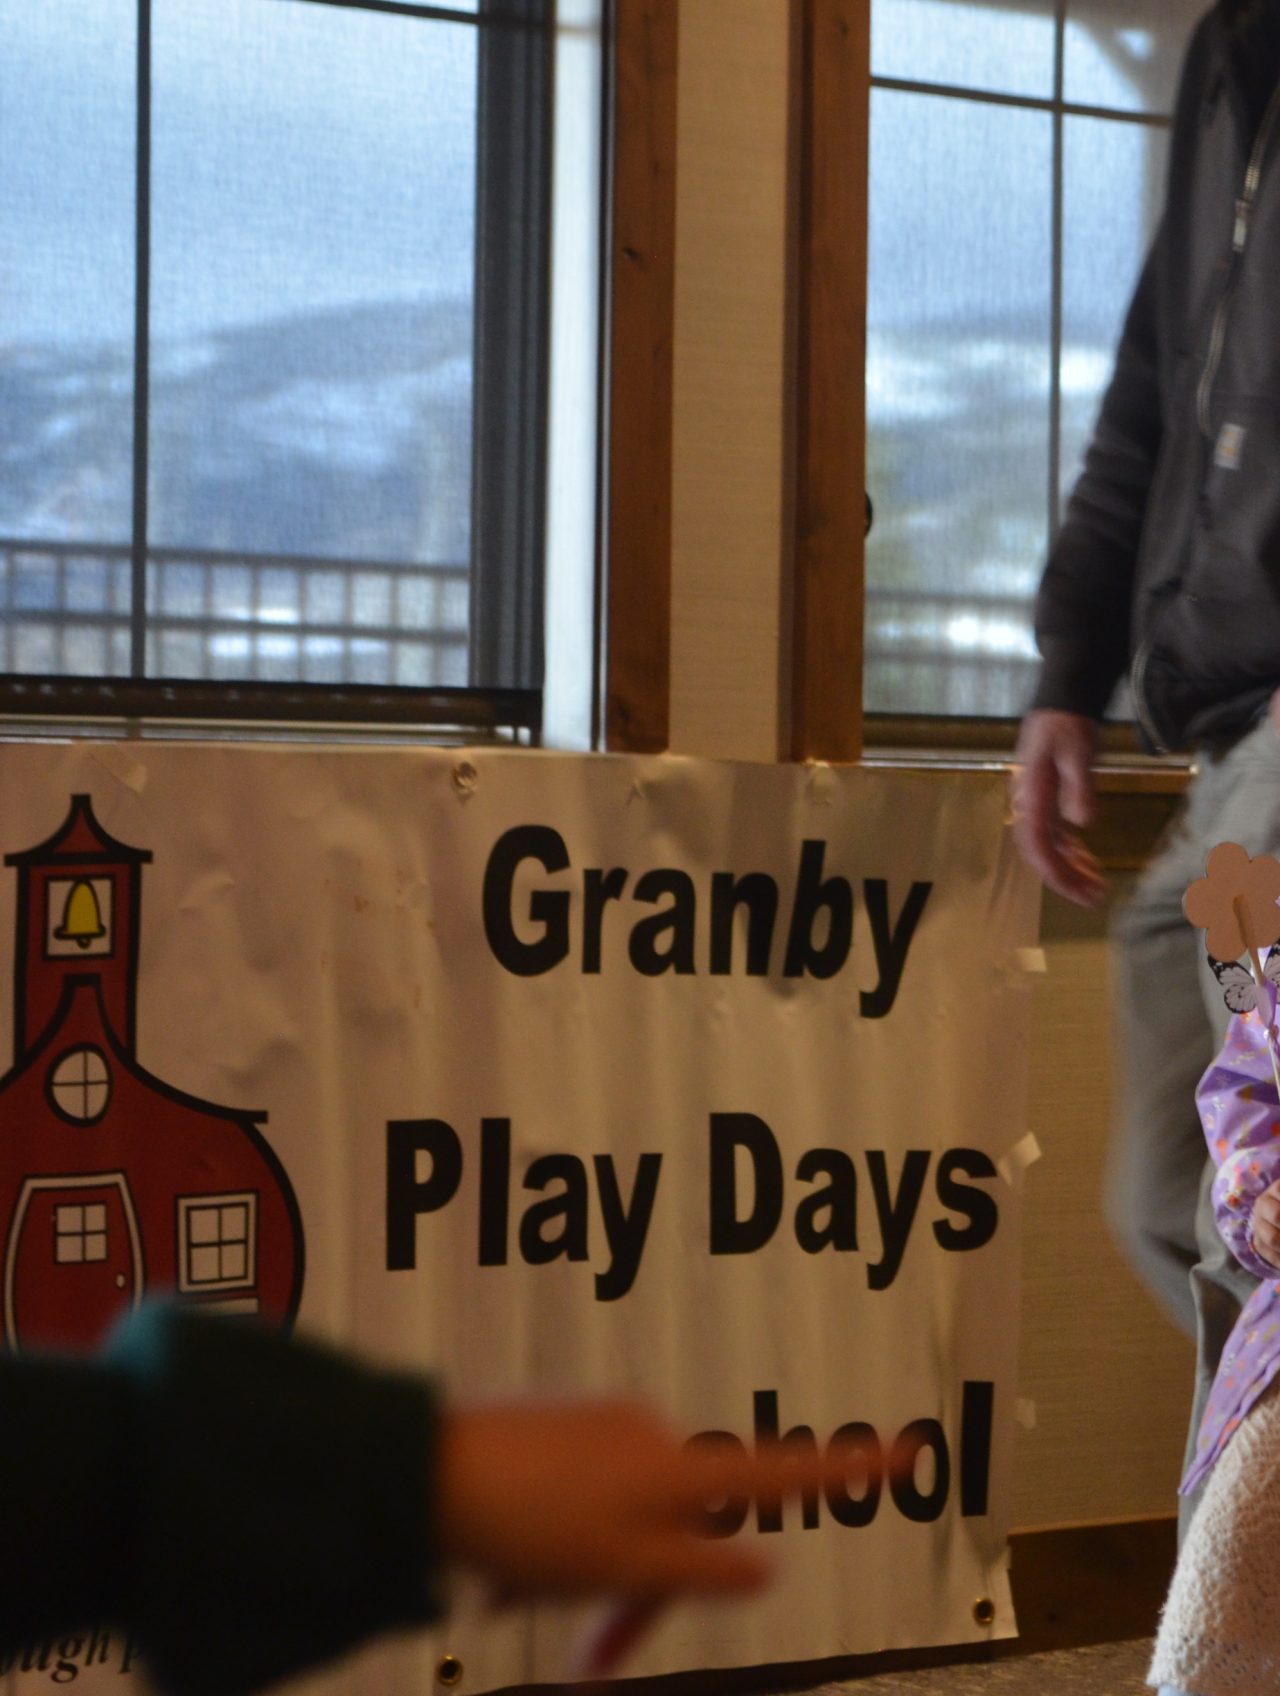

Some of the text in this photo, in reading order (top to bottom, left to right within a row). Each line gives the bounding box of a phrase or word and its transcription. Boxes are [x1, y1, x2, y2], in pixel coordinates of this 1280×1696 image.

[482, 825, 933, 1019] Granby
[386, 1111, 998, 1302] Play Days
[680, 1380, 994, 1540] chool
